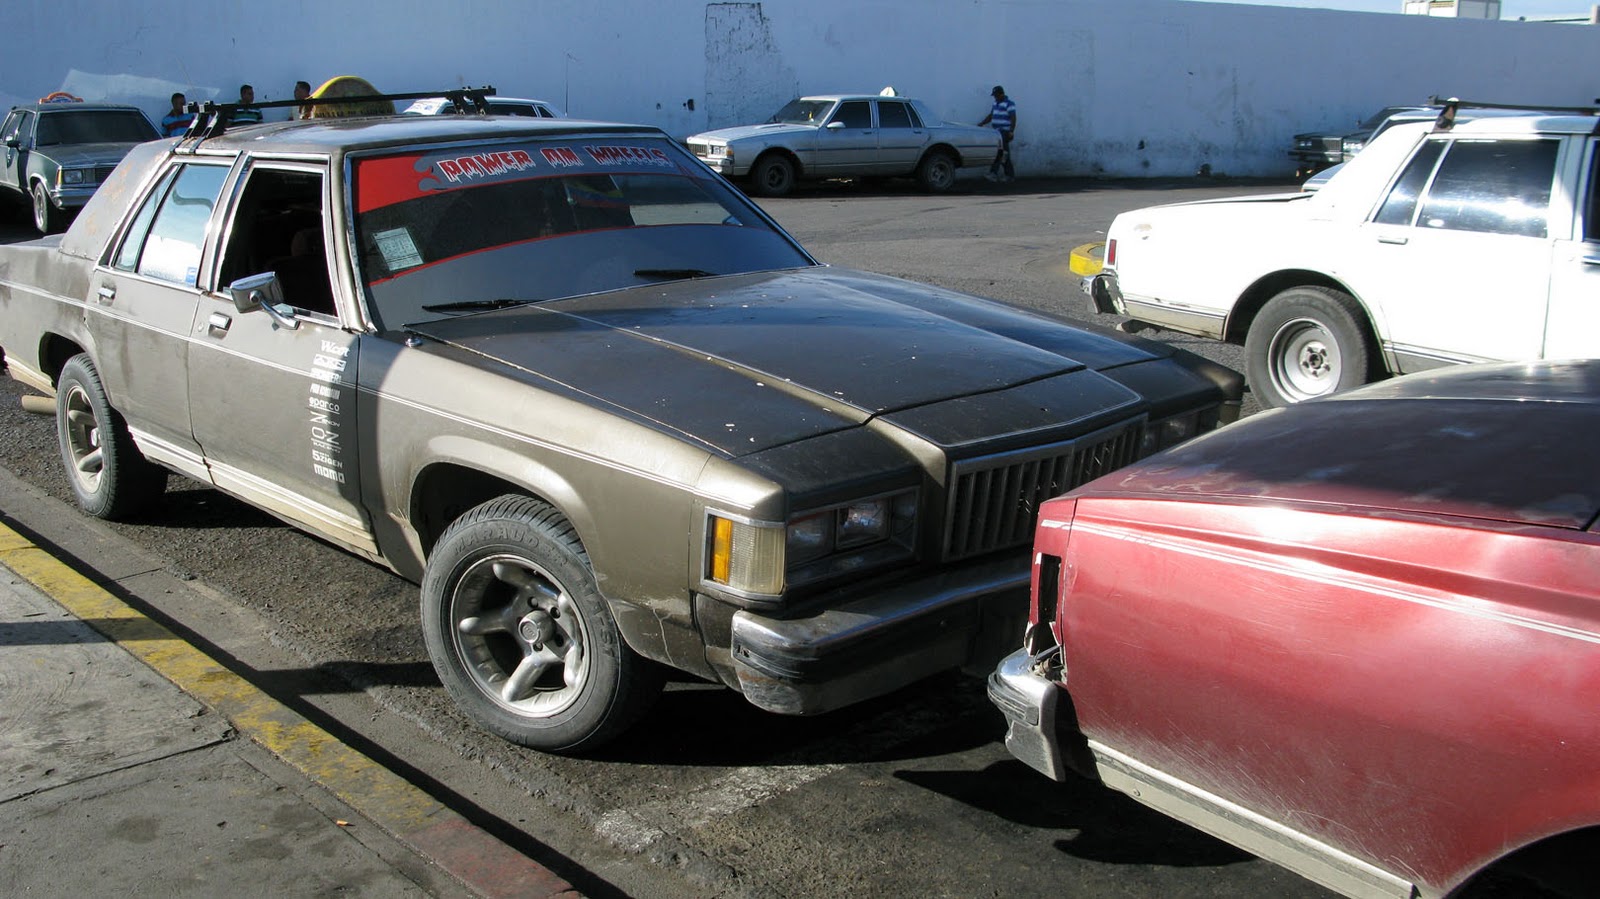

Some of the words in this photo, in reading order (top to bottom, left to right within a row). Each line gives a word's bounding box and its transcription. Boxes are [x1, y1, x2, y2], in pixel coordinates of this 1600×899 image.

[436, 149, 537, 183] POWER
[539, 146, 585, 167] ON
[585, 144, 676, 169] WHEELS
[309, 397, 340, 412] sparco
